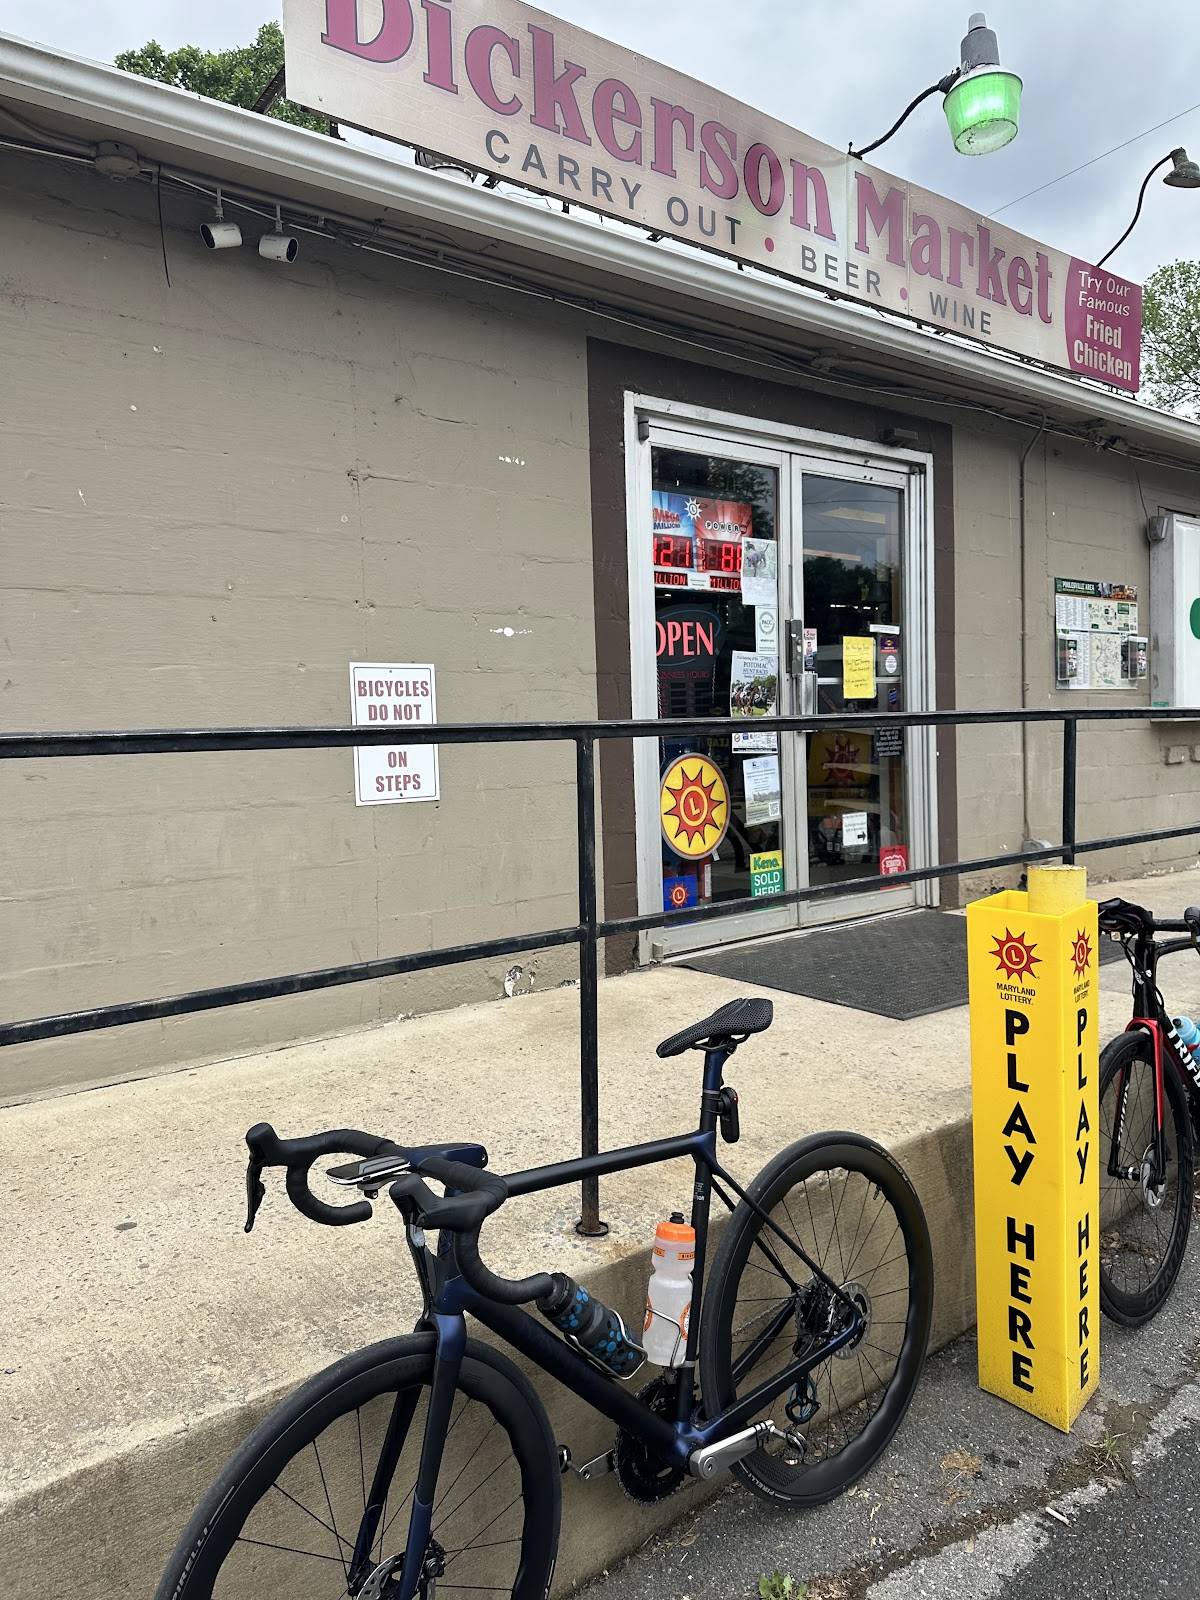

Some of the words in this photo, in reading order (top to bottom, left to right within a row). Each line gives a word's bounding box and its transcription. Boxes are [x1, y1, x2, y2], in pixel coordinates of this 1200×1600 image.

[485, 129, 641, 210] CARRY
[666, 196, 742, 245] OUT
[855, 171, 1052, 323] Market
[801, 244, 881, 297] BEER
[1079, 270, 1102, 293] Try
[1106, 277, 1131, 297] Our
[929, 291, 992, 335] WINE
[1079, 290, 1130, 317] Famous
[1086, 314, 1122, 349] Fried
[1073, 339, 1132, 381] Chicken
[655, 572, 686, 585] ILLION
[710, 577, 740, 590] MILLIO
[357, 680, 429, 697] BICYCLES
[368, 704, 388, 721] DO
[393, 704, 422, 721] NOT
[387, 751, 408, 768] ON
[375, 773, 421, 792] STEPS
[754, 871, 780, 886] SOLD
[754, 885, 781, 897] HERE
[996, 982, 1036, 996] MARYLAND
[1000, 992, 1033, 1005] LOTTERY
[1001, 1008, 1037, 1186] PLAY
[1076, 1007, 1090, 1185] PLAY
[1006, 1216, 1036, 1394] HERE
[1077, 1212, 1090, 1390] HERE
